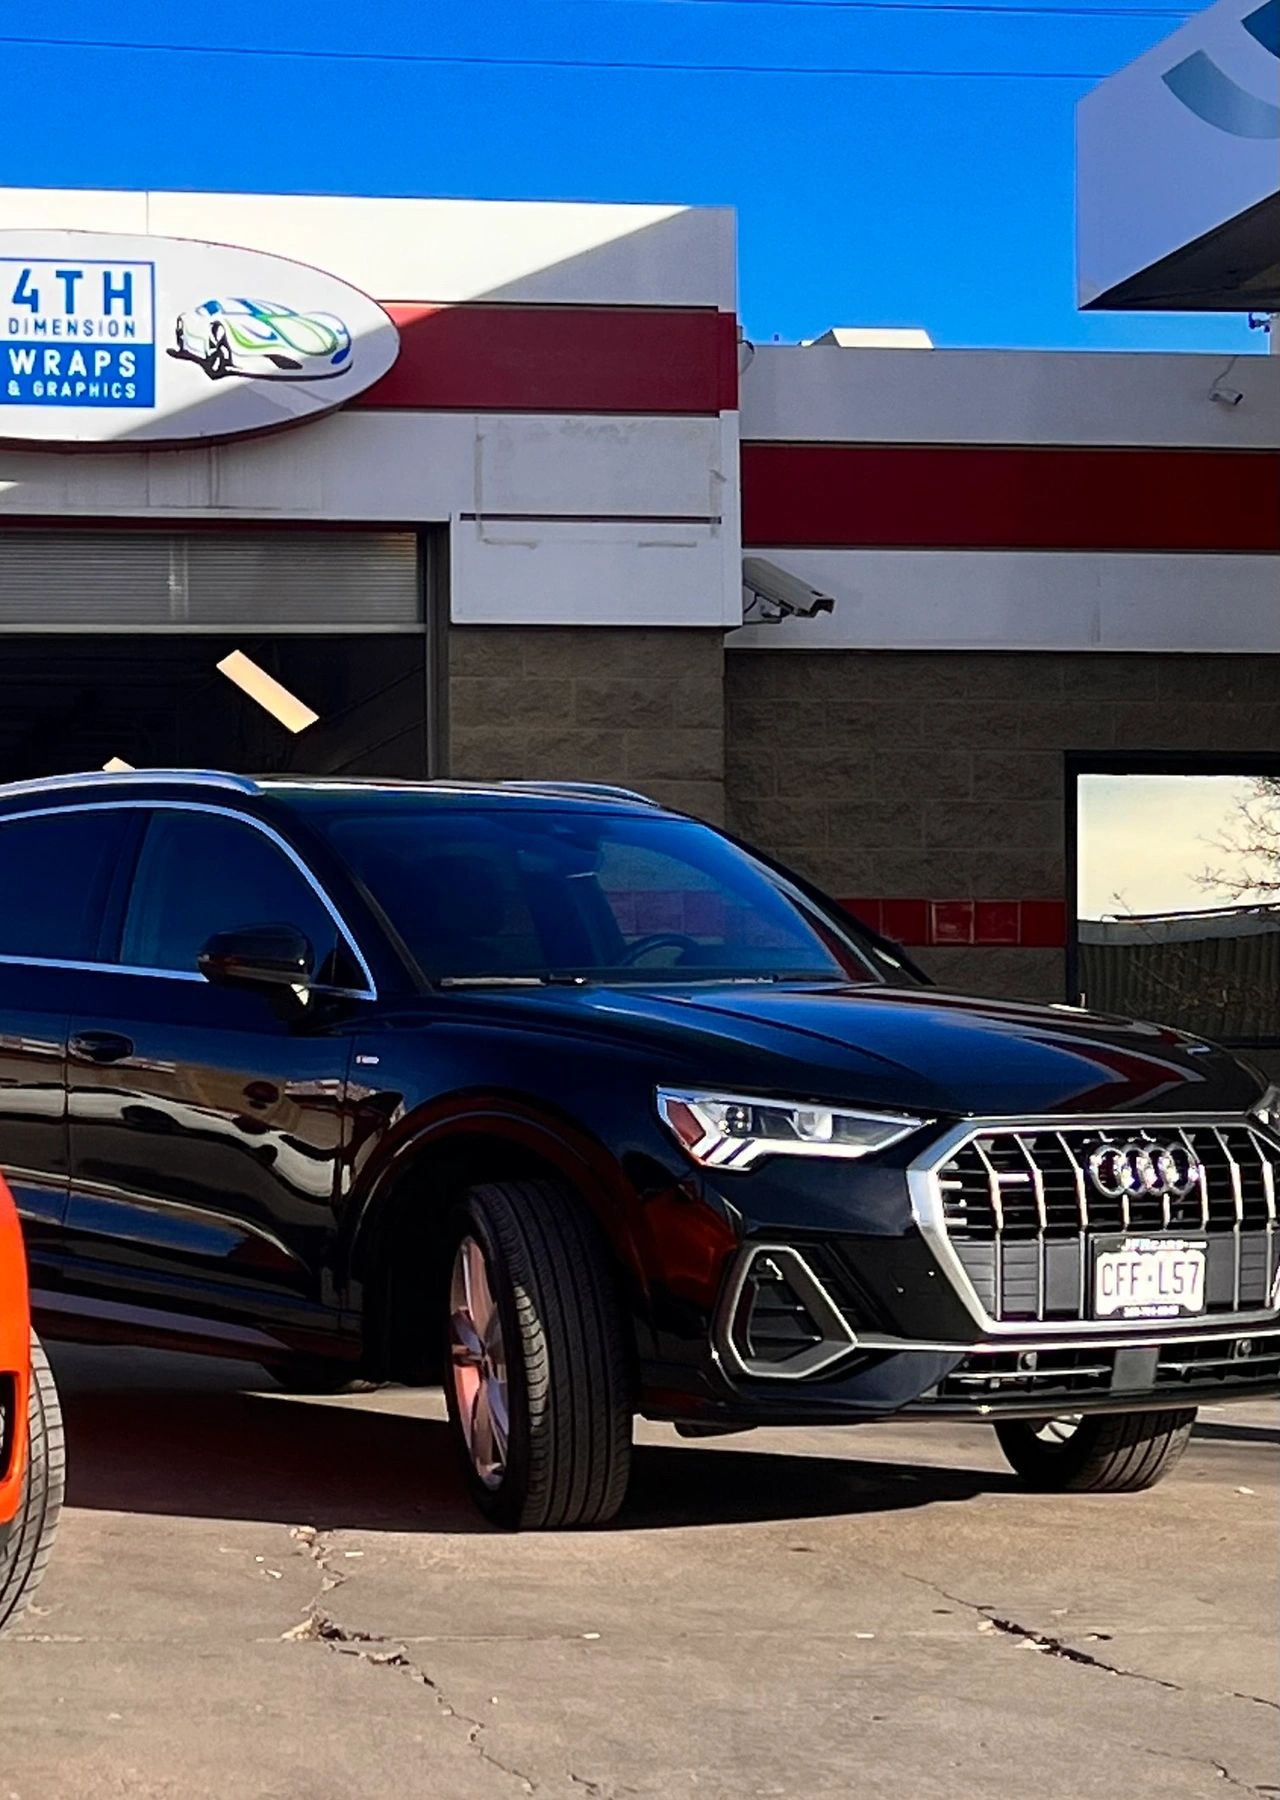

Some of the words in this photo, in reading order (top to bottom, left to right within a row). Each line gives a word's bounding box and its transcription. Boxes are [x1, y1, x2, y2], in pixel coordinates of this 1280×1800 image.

[11, 268, 133, 316] 4TH
[8, 317, 136, 338] DIMENSION
[8, 348, 137, 378] WRAPS
[7, 379, 21, 397] &
[32, 380, 137, 399] GRAPHICS
